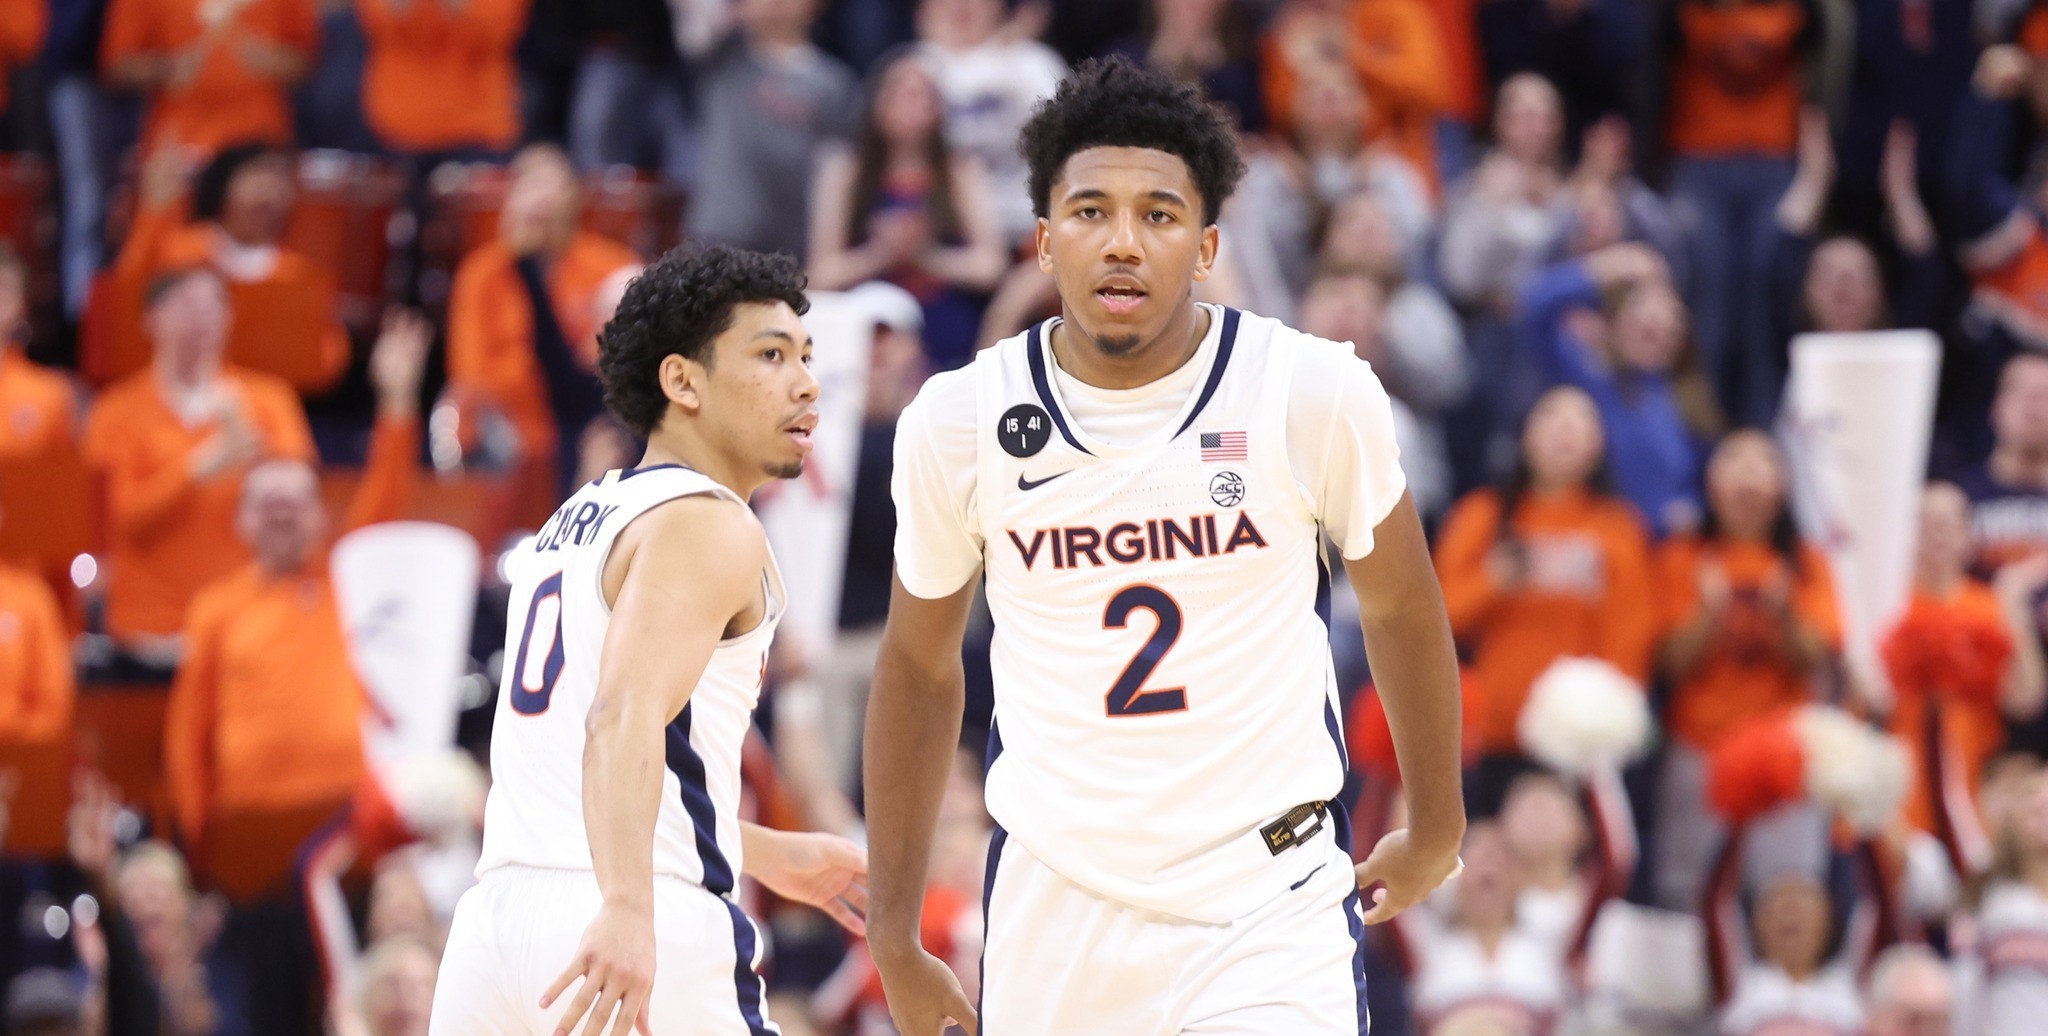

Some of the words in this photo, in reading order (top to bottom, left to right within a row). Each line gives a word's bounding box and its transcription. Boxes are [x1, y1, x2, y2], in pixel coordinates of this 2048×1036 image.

[1006, 417, 1019, 433] 15
[1027, 416, 1040, 430] 41
[535, 501, 620, 552] CLARK
[1007, 510, 1268, 571] VIRGINIA
[510, 570, 565, 717] 0
[1103, 582, 1188, 718] 2
